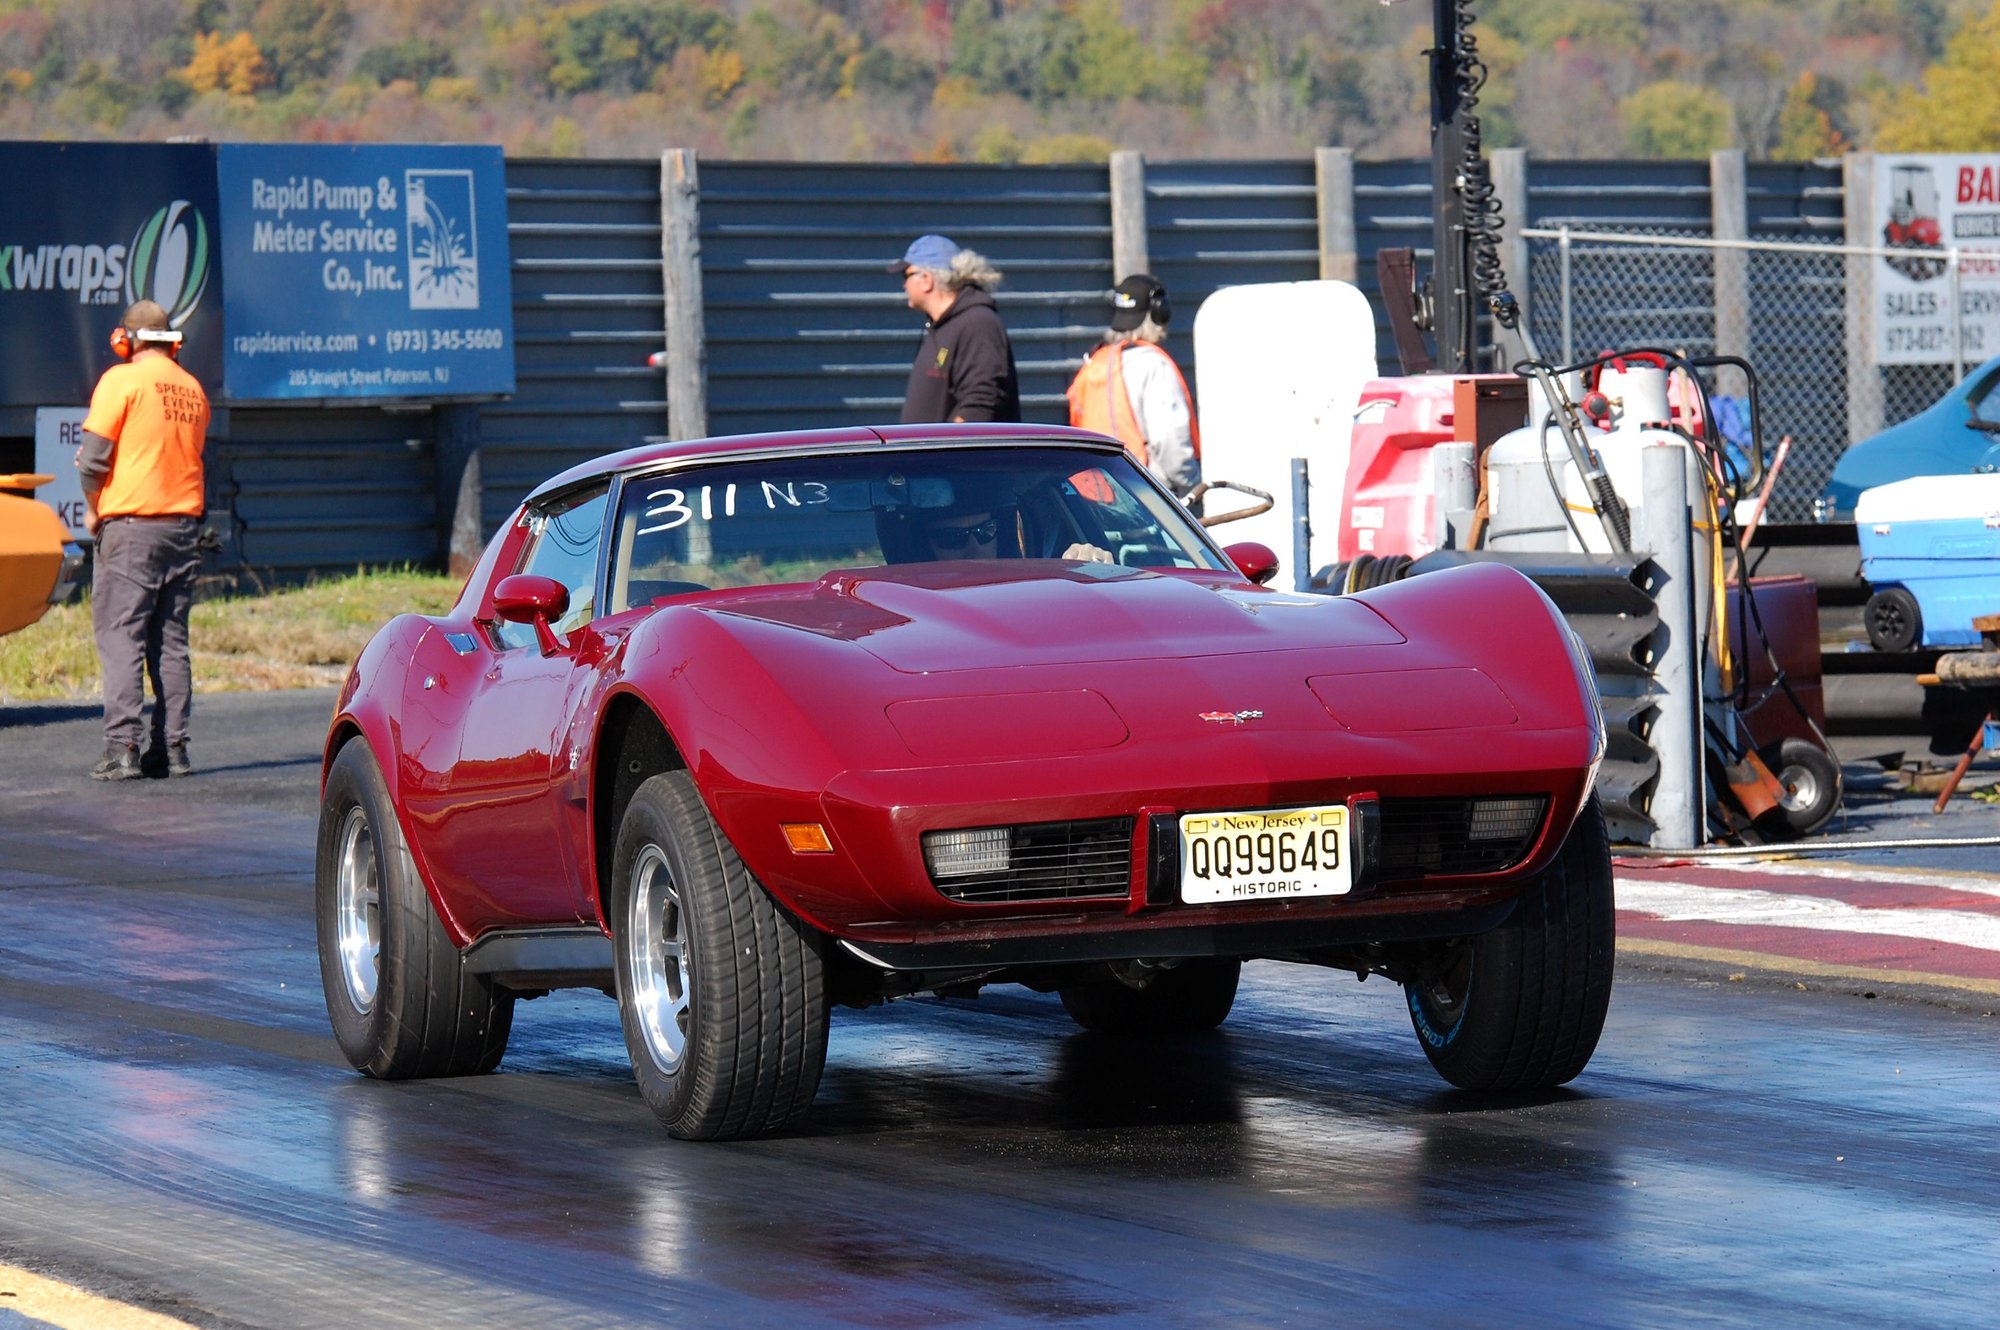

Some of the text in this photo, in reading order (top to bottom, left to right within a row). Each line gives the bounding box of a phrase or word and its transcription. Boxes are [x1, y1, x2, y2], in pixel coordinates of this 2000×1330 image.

[252, 176, 397, 219] Rapid Pump &
[1957, 165, 2000, 203] BA
[252, 218, 397, 252] Meter Service
[323, 258, 403, 297] Co., Inc.
[233, 328, 502, 358] rapidservice.com (973) 345-5600
[434, 366, 450, 384] NJ
[163, 396, 201, 414] EVENT
[164, 408, 200, 426] STAFF
[637, 483, 736, 536] 311
[1223, 814, 1307, 831] New Jersey
[1192, 829, 1339, 880] QQ99649
[1232, 880, 1302, 896] HISTORIC
